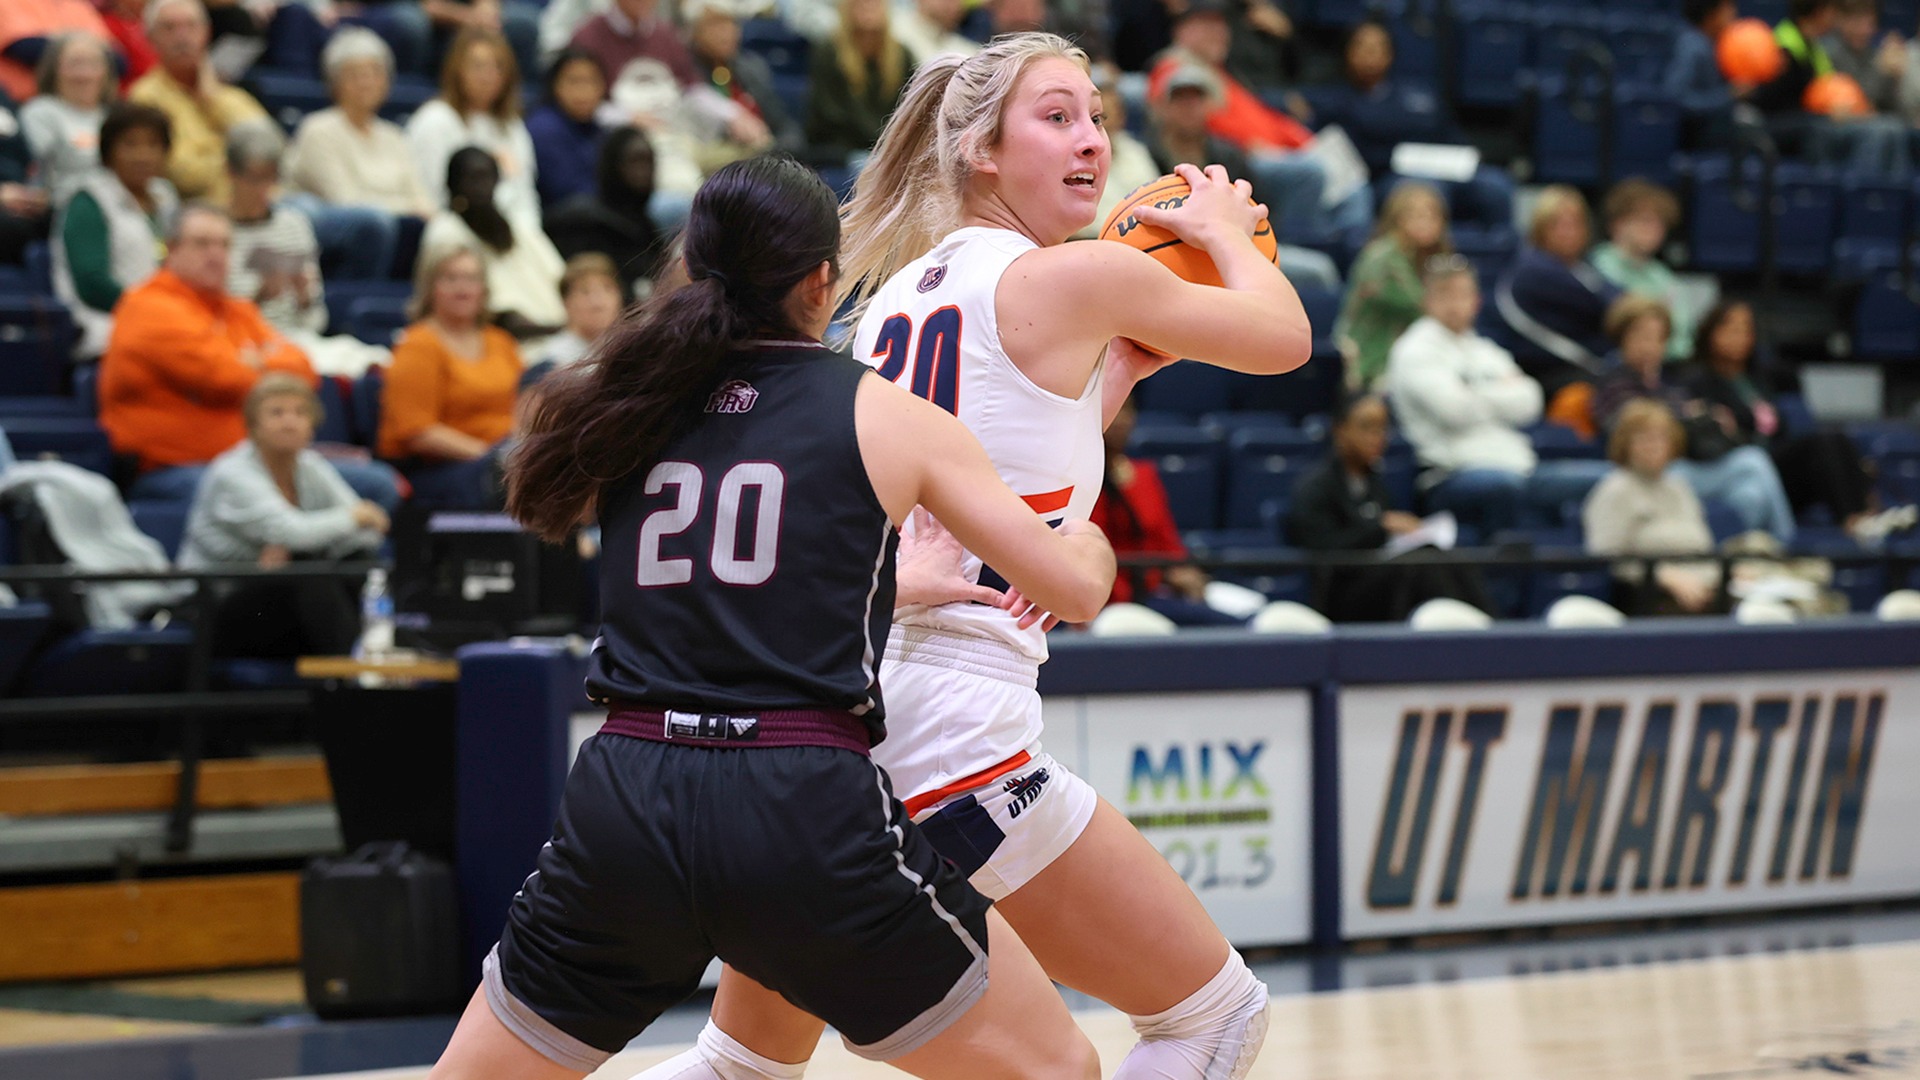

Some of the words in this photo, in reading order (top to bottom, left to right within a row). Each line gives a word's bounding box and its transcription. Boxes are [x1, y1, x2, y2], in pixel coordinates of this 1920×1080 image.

[636, 459, 786, 588] 20
[1127, 743, 1268, 802] MIX
[1367, 708, 1509, 909] UT
[1510, 692, 1887, 901] MARTIN
